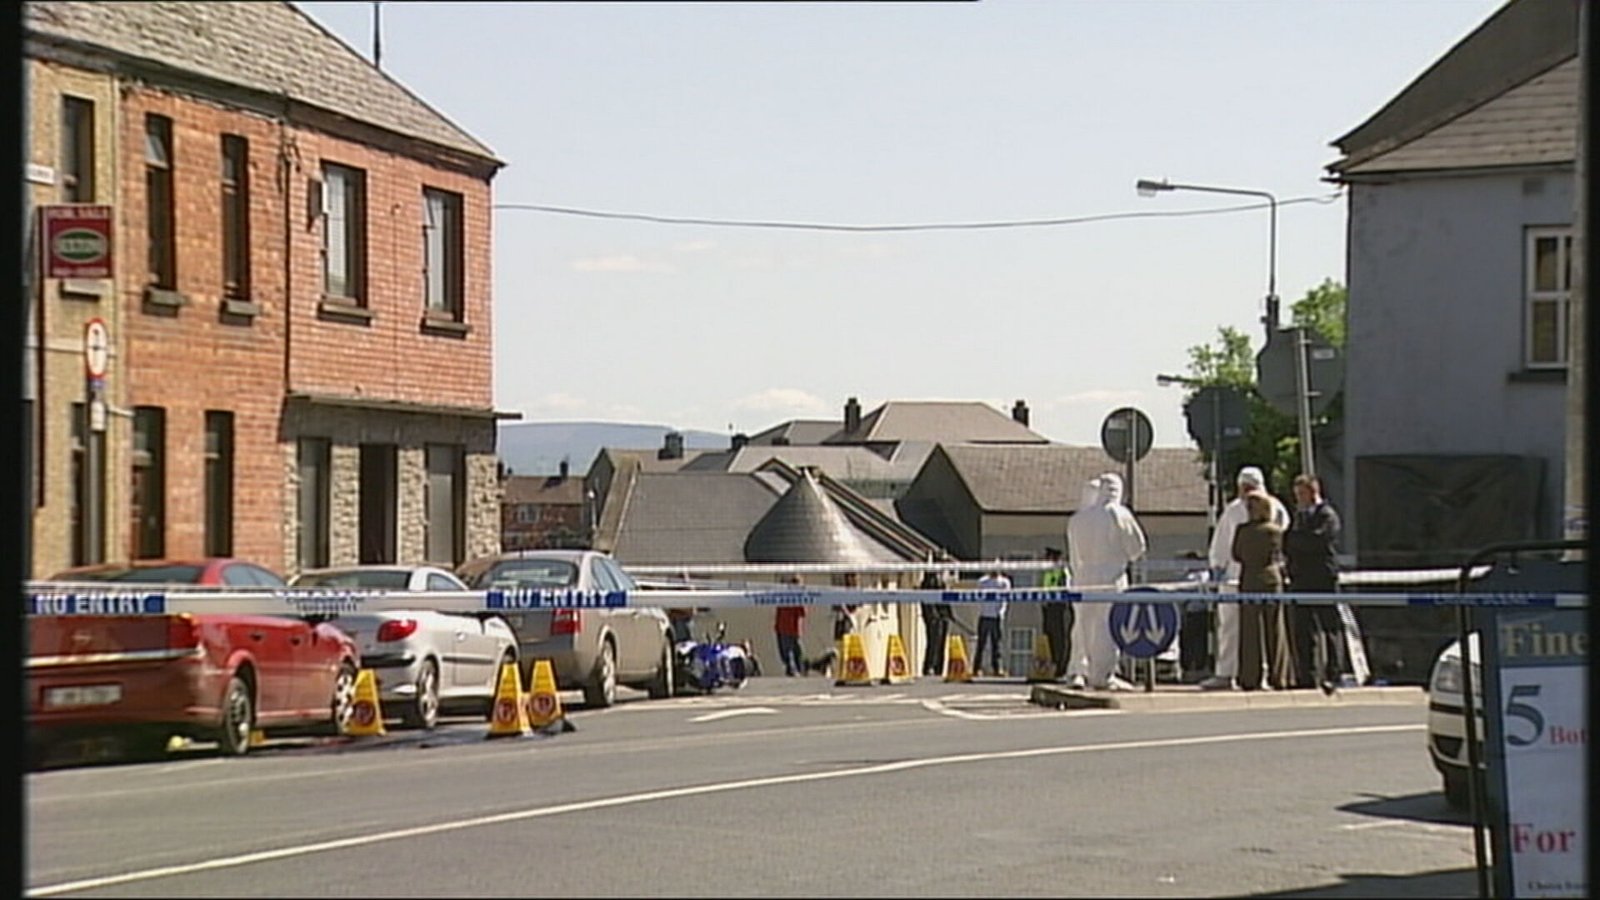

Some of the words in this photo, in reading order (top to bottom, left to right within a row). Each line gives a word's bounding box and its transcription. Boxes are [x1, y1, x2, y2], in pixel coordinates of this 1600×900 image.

[37, 593, 67, 614] NO
[75, 591, 148, 614] ENTRY
[503, 588, 531, 608] NO
[540, 587, 608, 608] ENTRY
[1503, 623, 1589, 656] Fine
[1506, 684, 1545, 746] 5
[1512, 823, 1576, 854] For
